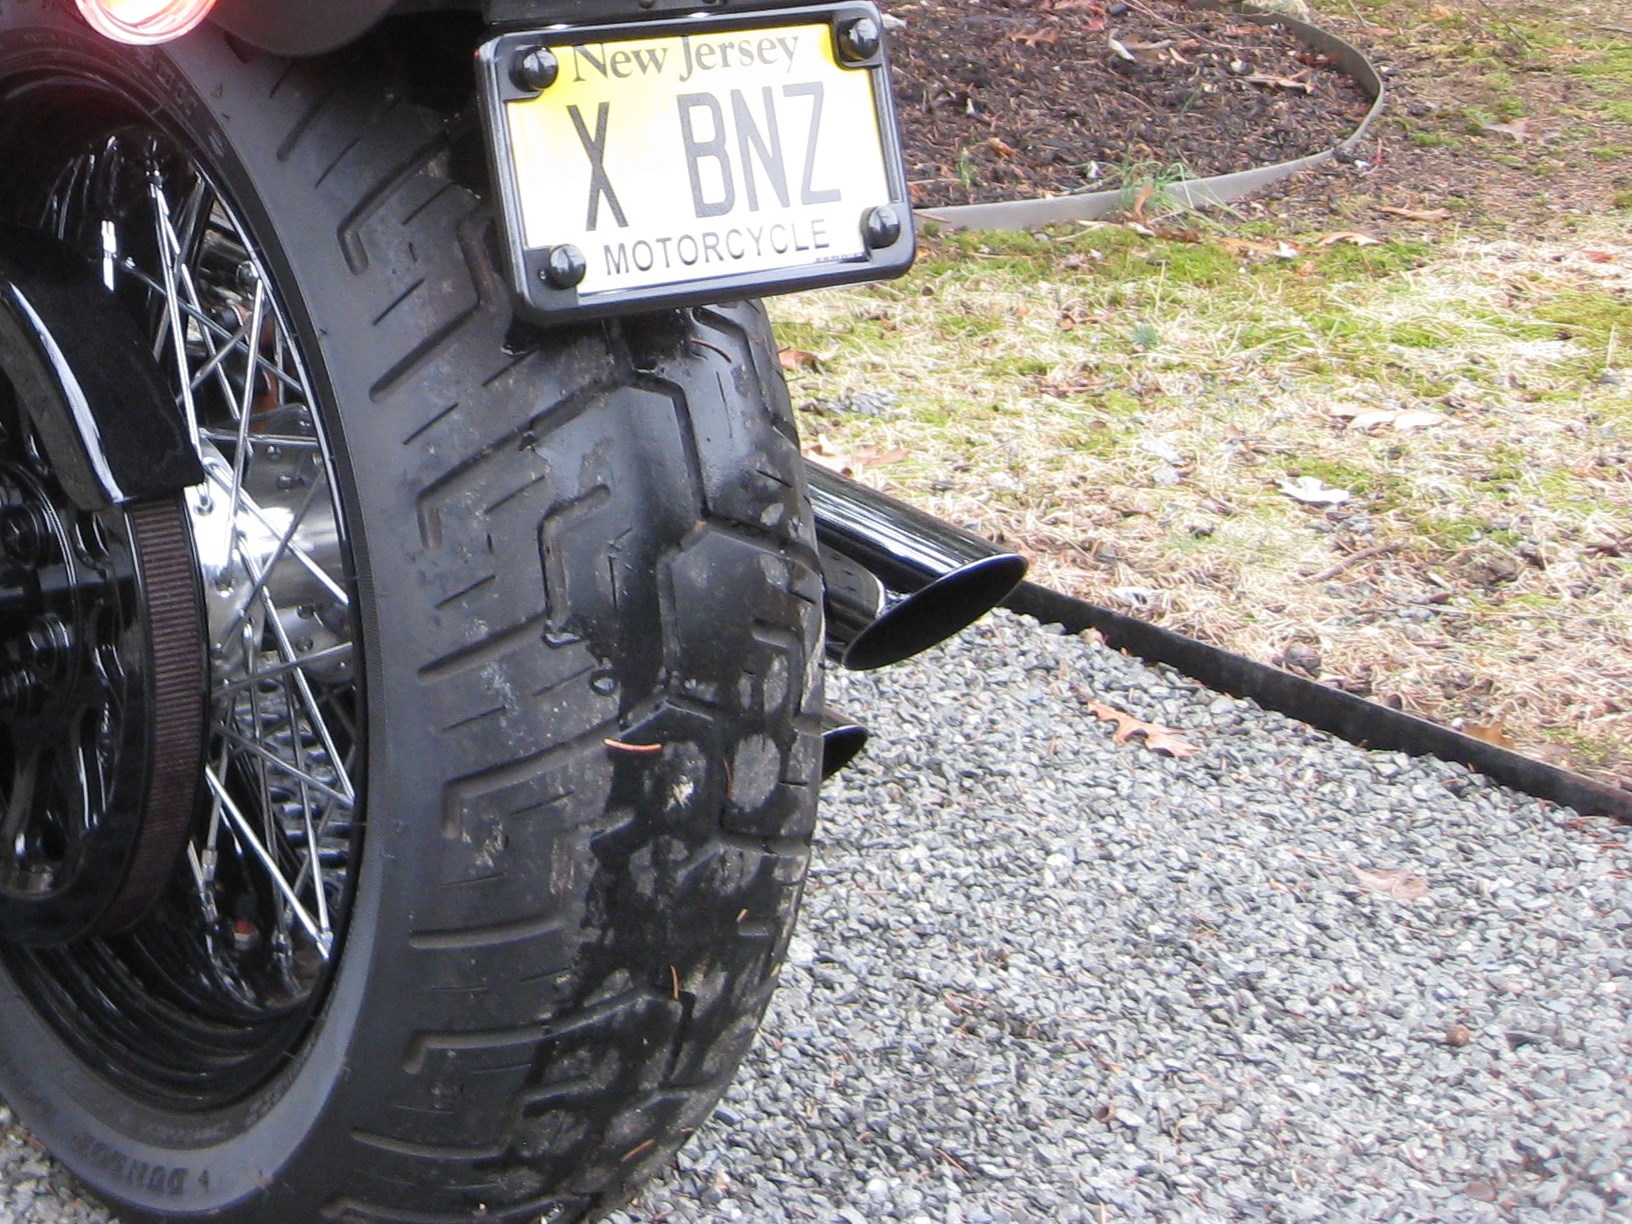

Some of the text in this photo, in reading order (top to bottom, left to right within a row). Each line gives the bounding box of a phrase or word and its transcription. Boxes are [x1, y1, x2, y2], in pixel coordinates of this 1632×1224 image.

[572, 34, 799, 84] New Jersey
[566, 81, 843, 232] X BNZ
[604, 219, 830, 276] MOTORCYCLE
